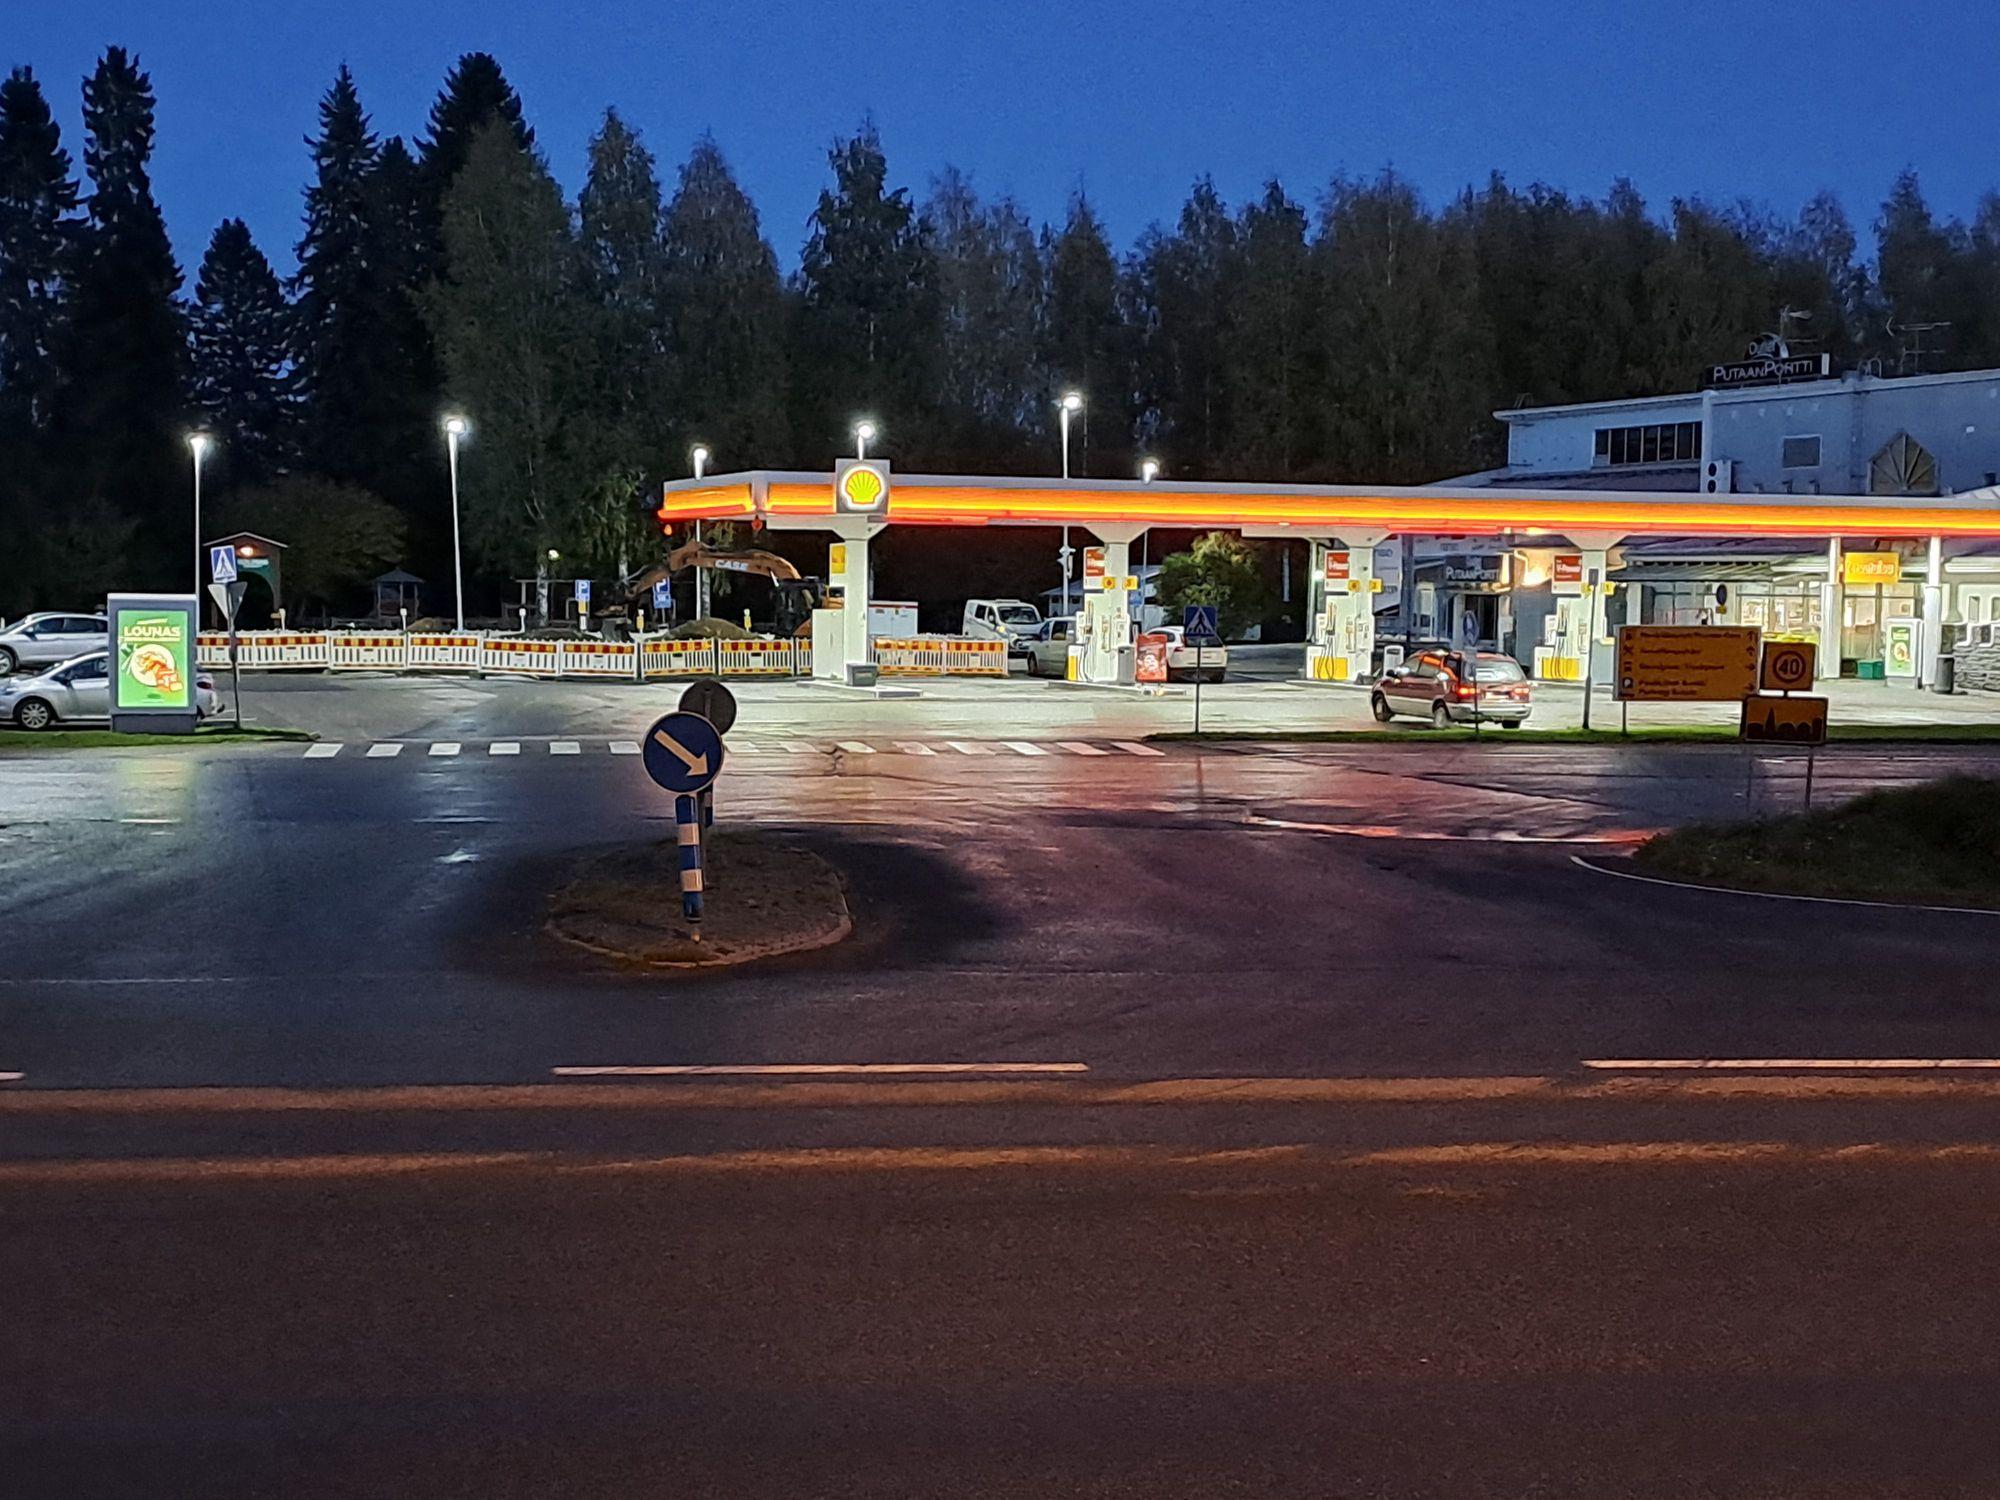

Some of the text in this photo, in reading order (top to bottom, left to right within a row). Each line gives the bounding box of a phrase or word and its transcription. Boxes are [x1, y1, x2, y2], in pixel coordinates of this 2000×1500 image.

[1713, 360, 1813, 381] PUTAANPORTTI
[715, 559, 749, 571] CASE
[124, 626, 181, 638] LOUNAS
[1778, 658, 1800, 675] 40
